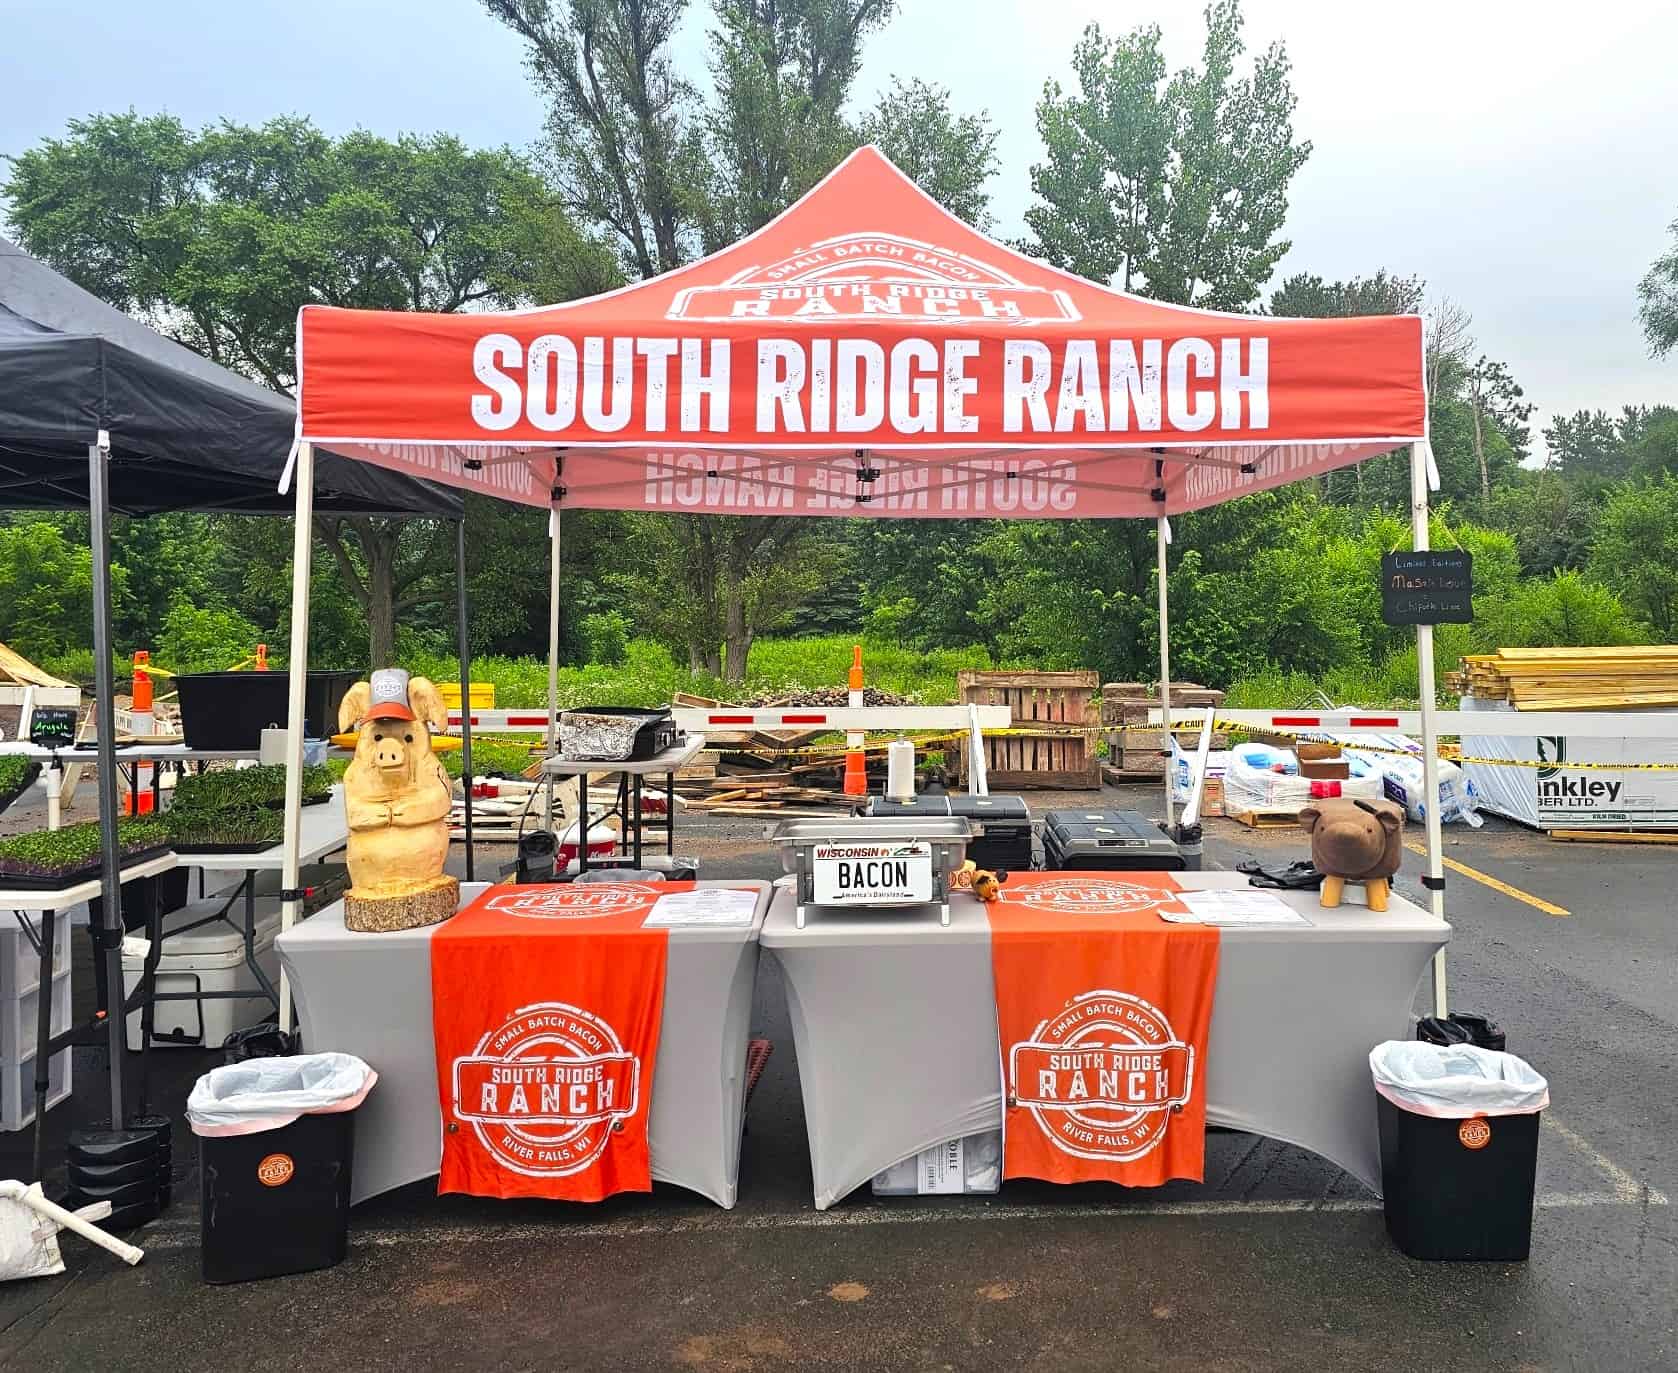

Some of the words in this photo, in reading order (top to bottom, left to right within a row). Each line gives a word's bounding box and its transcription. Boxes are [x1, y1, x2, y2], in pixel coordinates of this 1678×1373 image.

[769, 255, 828, 278] SMALL
[834, 244, 904, 256] BATCH
[912, 252, 980, 280] BACON
[761, 285, 871, 300] SOUTH
[890, 285, 990, 300] RIDGE
[731, 296, 1023, 317] RANCH
[471, 333, 730, 433] SOUTH
[756, 338, 979, 434] RIDGE
[1003, 336, 1269, 433] RANCH
[1569, 797, 1598, 807] LTD.
[817, 847, 879, 858] WISCONSIN
[838, 861, 908, 888] BACON
[494, 1024, 525, 1050] SMALL
[528, 1016, 565, 1029] BATCH
[569, 1023, 603, 1050] BACON
[1051, 1011, 1083, 1039] SMALL
[1086, 1003, 1123, 1016] BATCH
[1126, 1010, 1160, 1040] BACON
[492, 1066, 548, 1084] SOUTH
[555, 1065, 604, 1082] RIDGE
[1050, 1054, 1105, 1071] SOUTH
[1113, 1054, 1162, 1071] RIDGE
[480, 1079, 615, 1114] RANCH
[1039, 1068, 1169, 1101] RANCH
[1062, 1121, 1093, 1143] RIVER
[1134, 1124, 1150, 1139] WI
[501, 1135, 534, 1159] RIVER
[575, 1136, 592, 1151] WI
